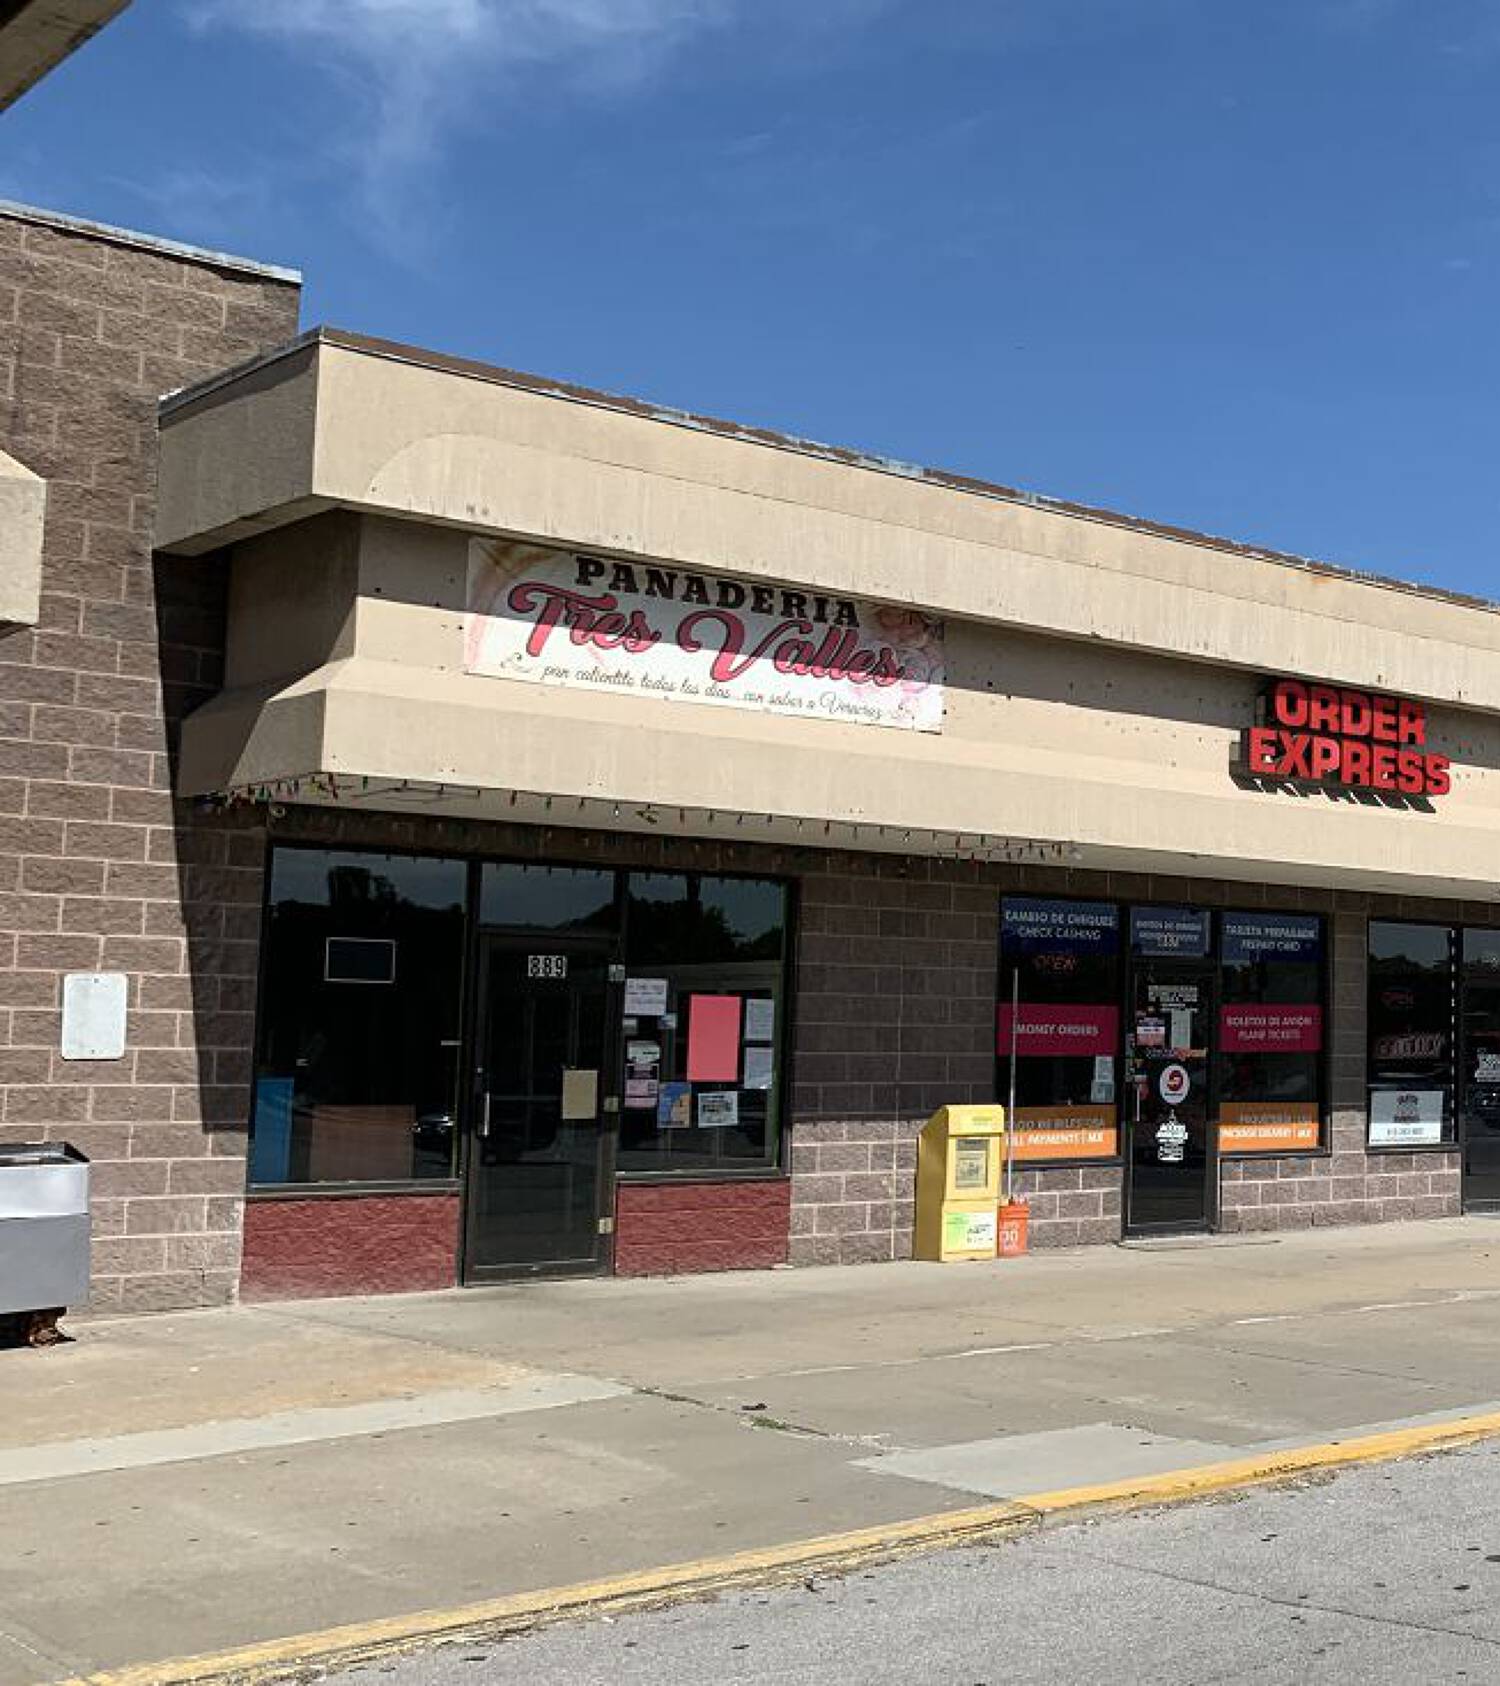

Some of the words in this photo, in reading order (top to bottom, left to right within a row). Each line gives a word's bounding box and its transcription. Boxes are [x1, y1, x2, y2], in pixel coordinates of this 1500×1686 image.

[574, 556, 859, 628] PANADERIA
[508, 582, 661, 657] Tres
[676, 609, 904, 686] Valles
[1275, 679, 1426, 745] ORDER
[1250, 726, 1451, 796] EXPRESS
[528, 954, 567, 978] 889
